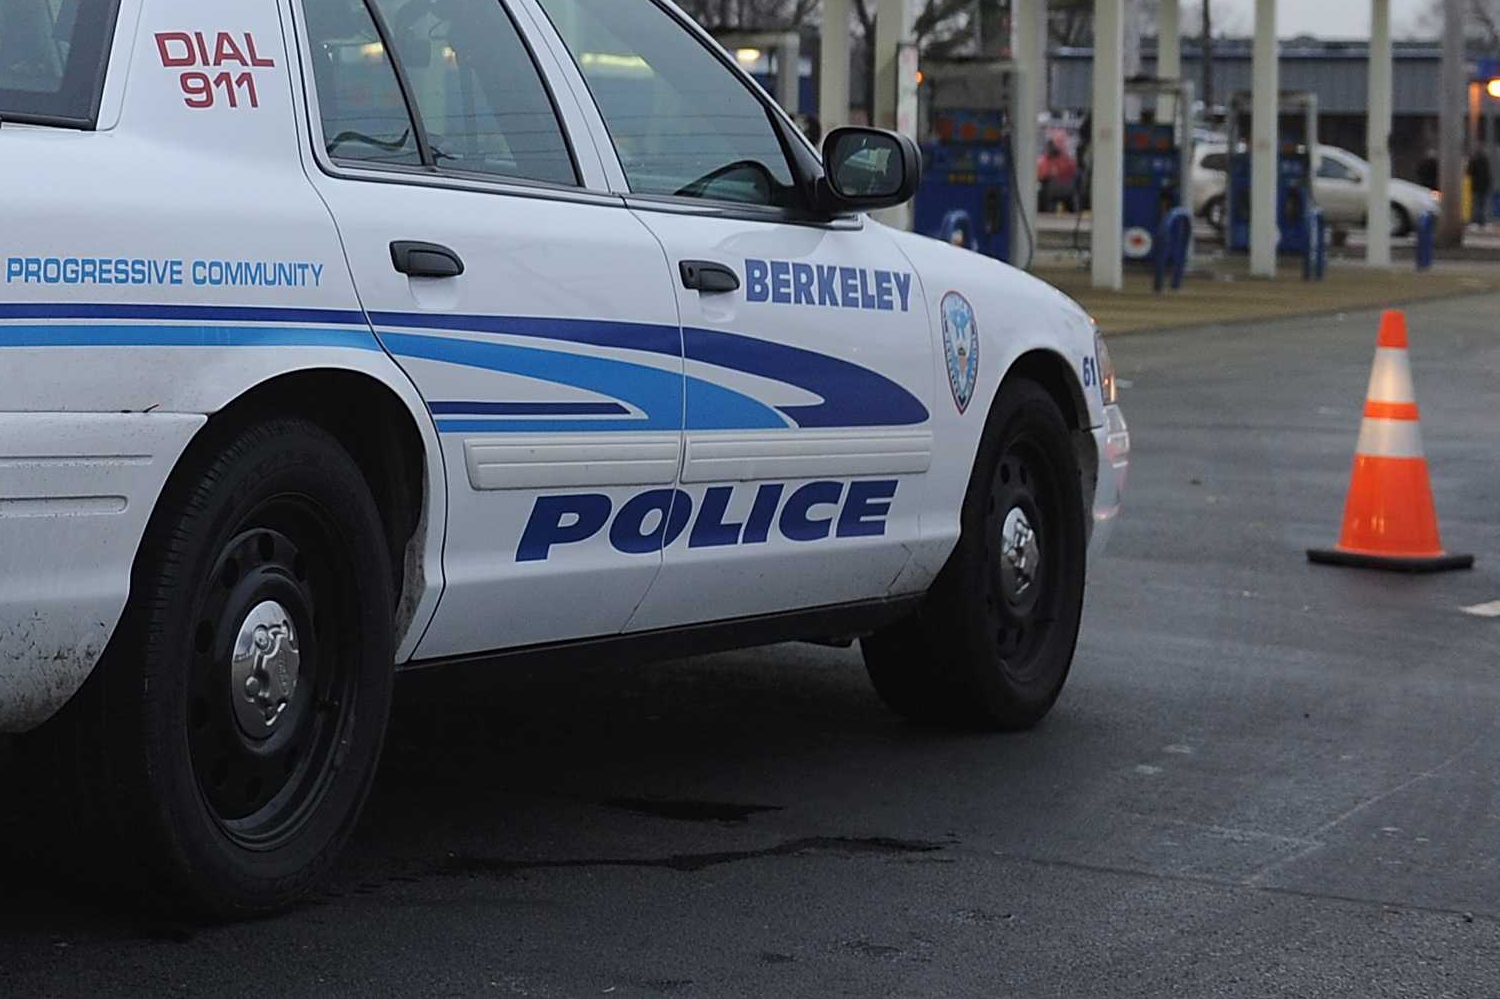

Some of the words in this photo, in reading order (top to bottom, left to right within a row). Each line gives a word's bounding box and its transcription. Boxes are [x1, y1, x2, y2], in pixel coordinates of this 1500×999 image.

[153, 31, 275, 68] DIAL
[179, 71, 260, 109] 911
[7, 257, 184, 286] PROGRESSIVE
[192, 260, 324, 287] COMMUNITY
[745, 258, 911, 312] BERKELEY
[1083, 356, 1096, 387] 61
[515, 480, 899, 562] POLICE
